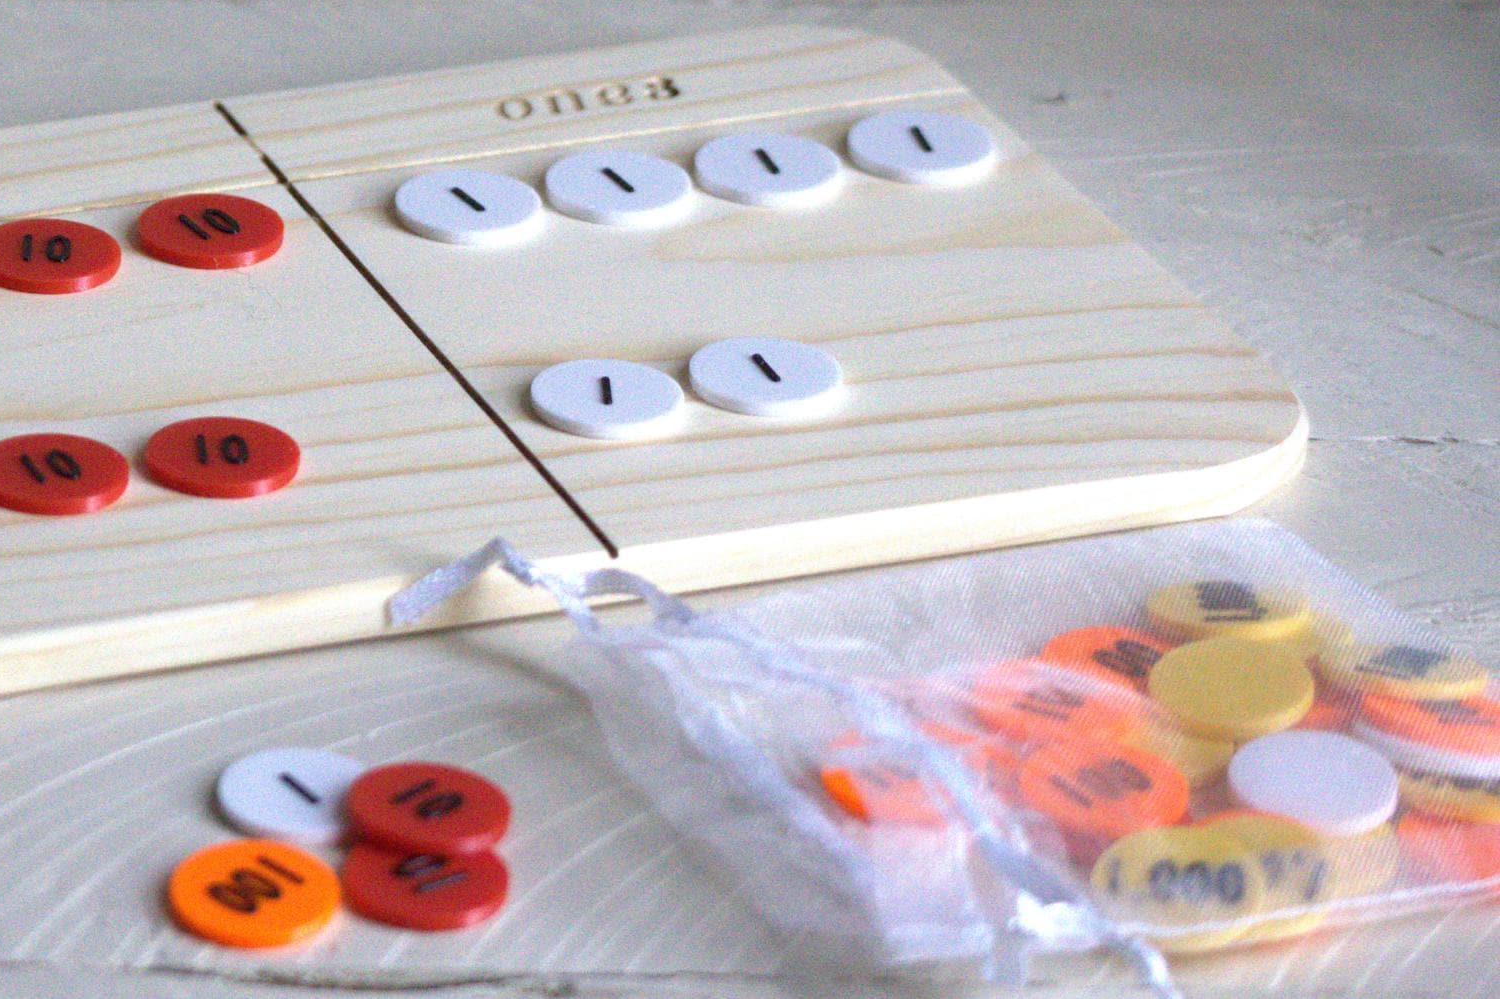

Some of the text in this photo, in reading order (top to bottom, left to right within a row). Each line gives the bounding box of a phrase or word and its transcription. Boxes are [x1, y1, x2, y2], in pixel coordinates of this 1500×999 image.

[498, 76, 681, 121] ones
[909, 124, 936, 153] 1
[754, 147, 782, 175] 1
[600, 166, 636, 194] 1
[449, 185, 486, 213] 1
[177, 206, 242, 241] 10
[20, 232, 72, 264] 10
[751, 352, 782, 384] 1
[599, 375, 615, 406] 1
[195, 432, 251, 466] 10
[20, 447, 83, 485] 10
[277, 771, 320, 805] 1
[390, 778, 466, 819] 10
